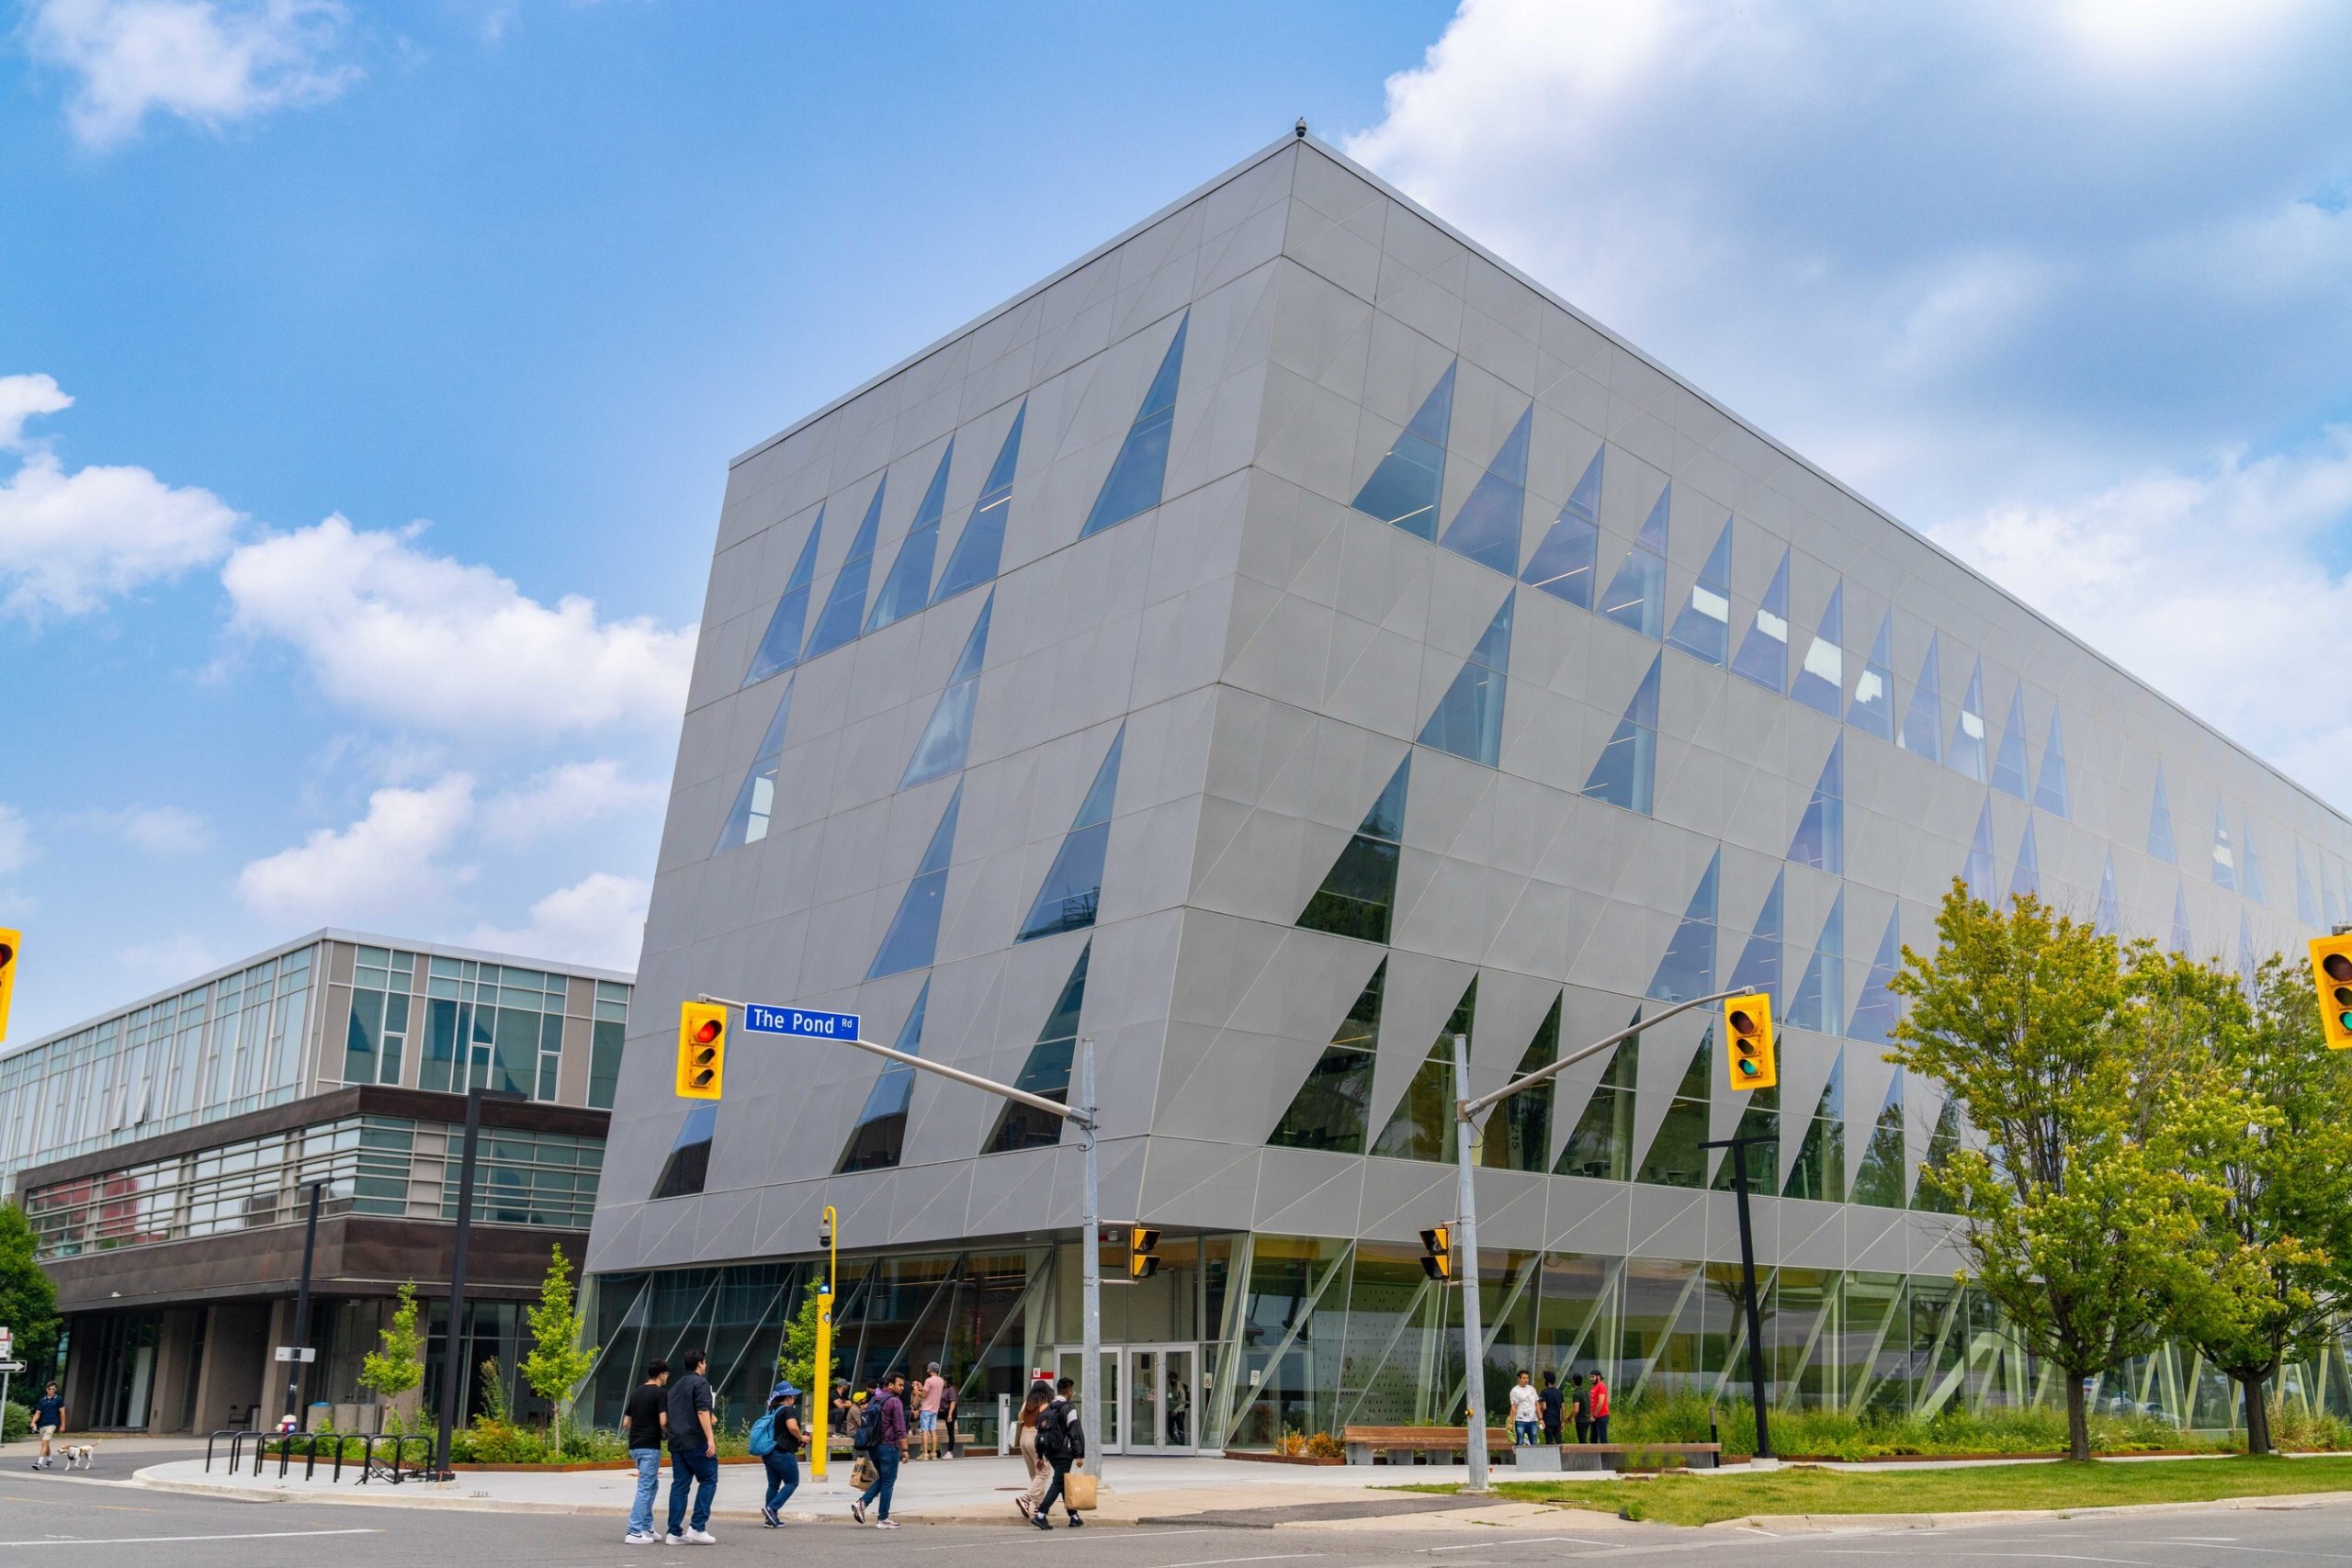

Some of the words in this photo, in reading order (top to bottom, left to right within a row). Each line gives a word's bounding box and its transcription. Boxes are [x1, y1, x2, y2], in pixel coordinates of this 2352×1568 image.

[754, 1009, 784, 1029] The
[793, 1013, 834, 1034] Pond
[842, 1019, 853, 1028] Rd
[1511, 1124, 1520, 1149] 215
